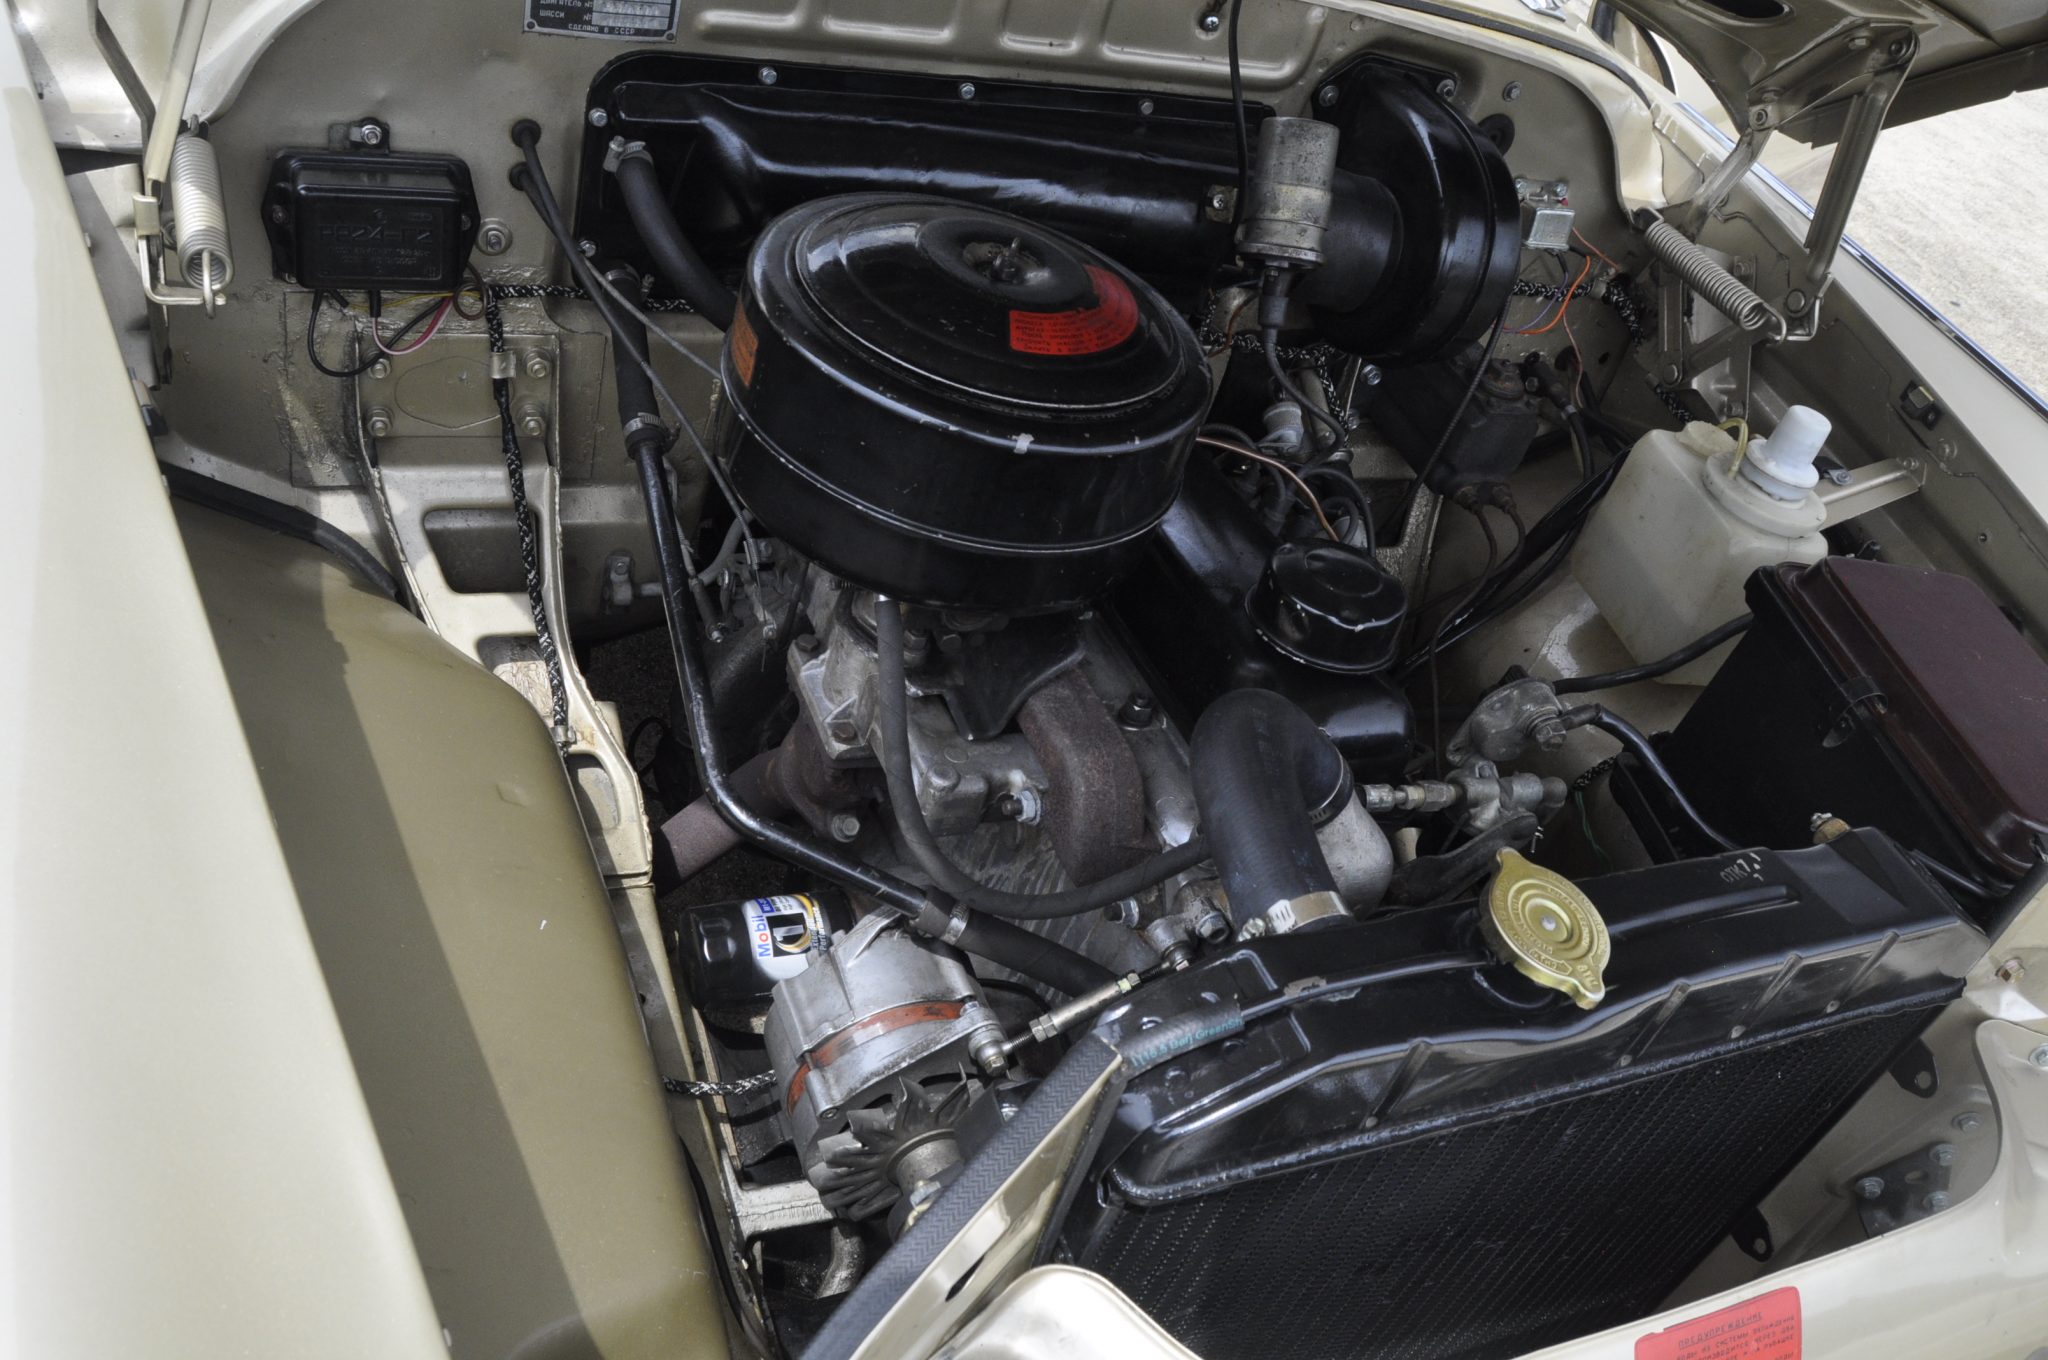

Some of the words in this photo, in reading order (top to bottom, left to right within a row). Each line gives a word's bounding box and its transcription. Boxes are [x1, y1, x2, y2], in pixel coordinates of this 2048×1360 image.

[540, 9, 565, 18] ШАССИ
[568, 23, 599, 33] СДЕЛАНО
[604, 26, 609, 34] В
[614, 27, 636, 35] СССР
[751, 915, 770, 958] Mobil
[772, 924, 805, 942] 1
[1678, 1311, 1763, 1348] ПРЕДУПРЕЖДЕНИЕ
